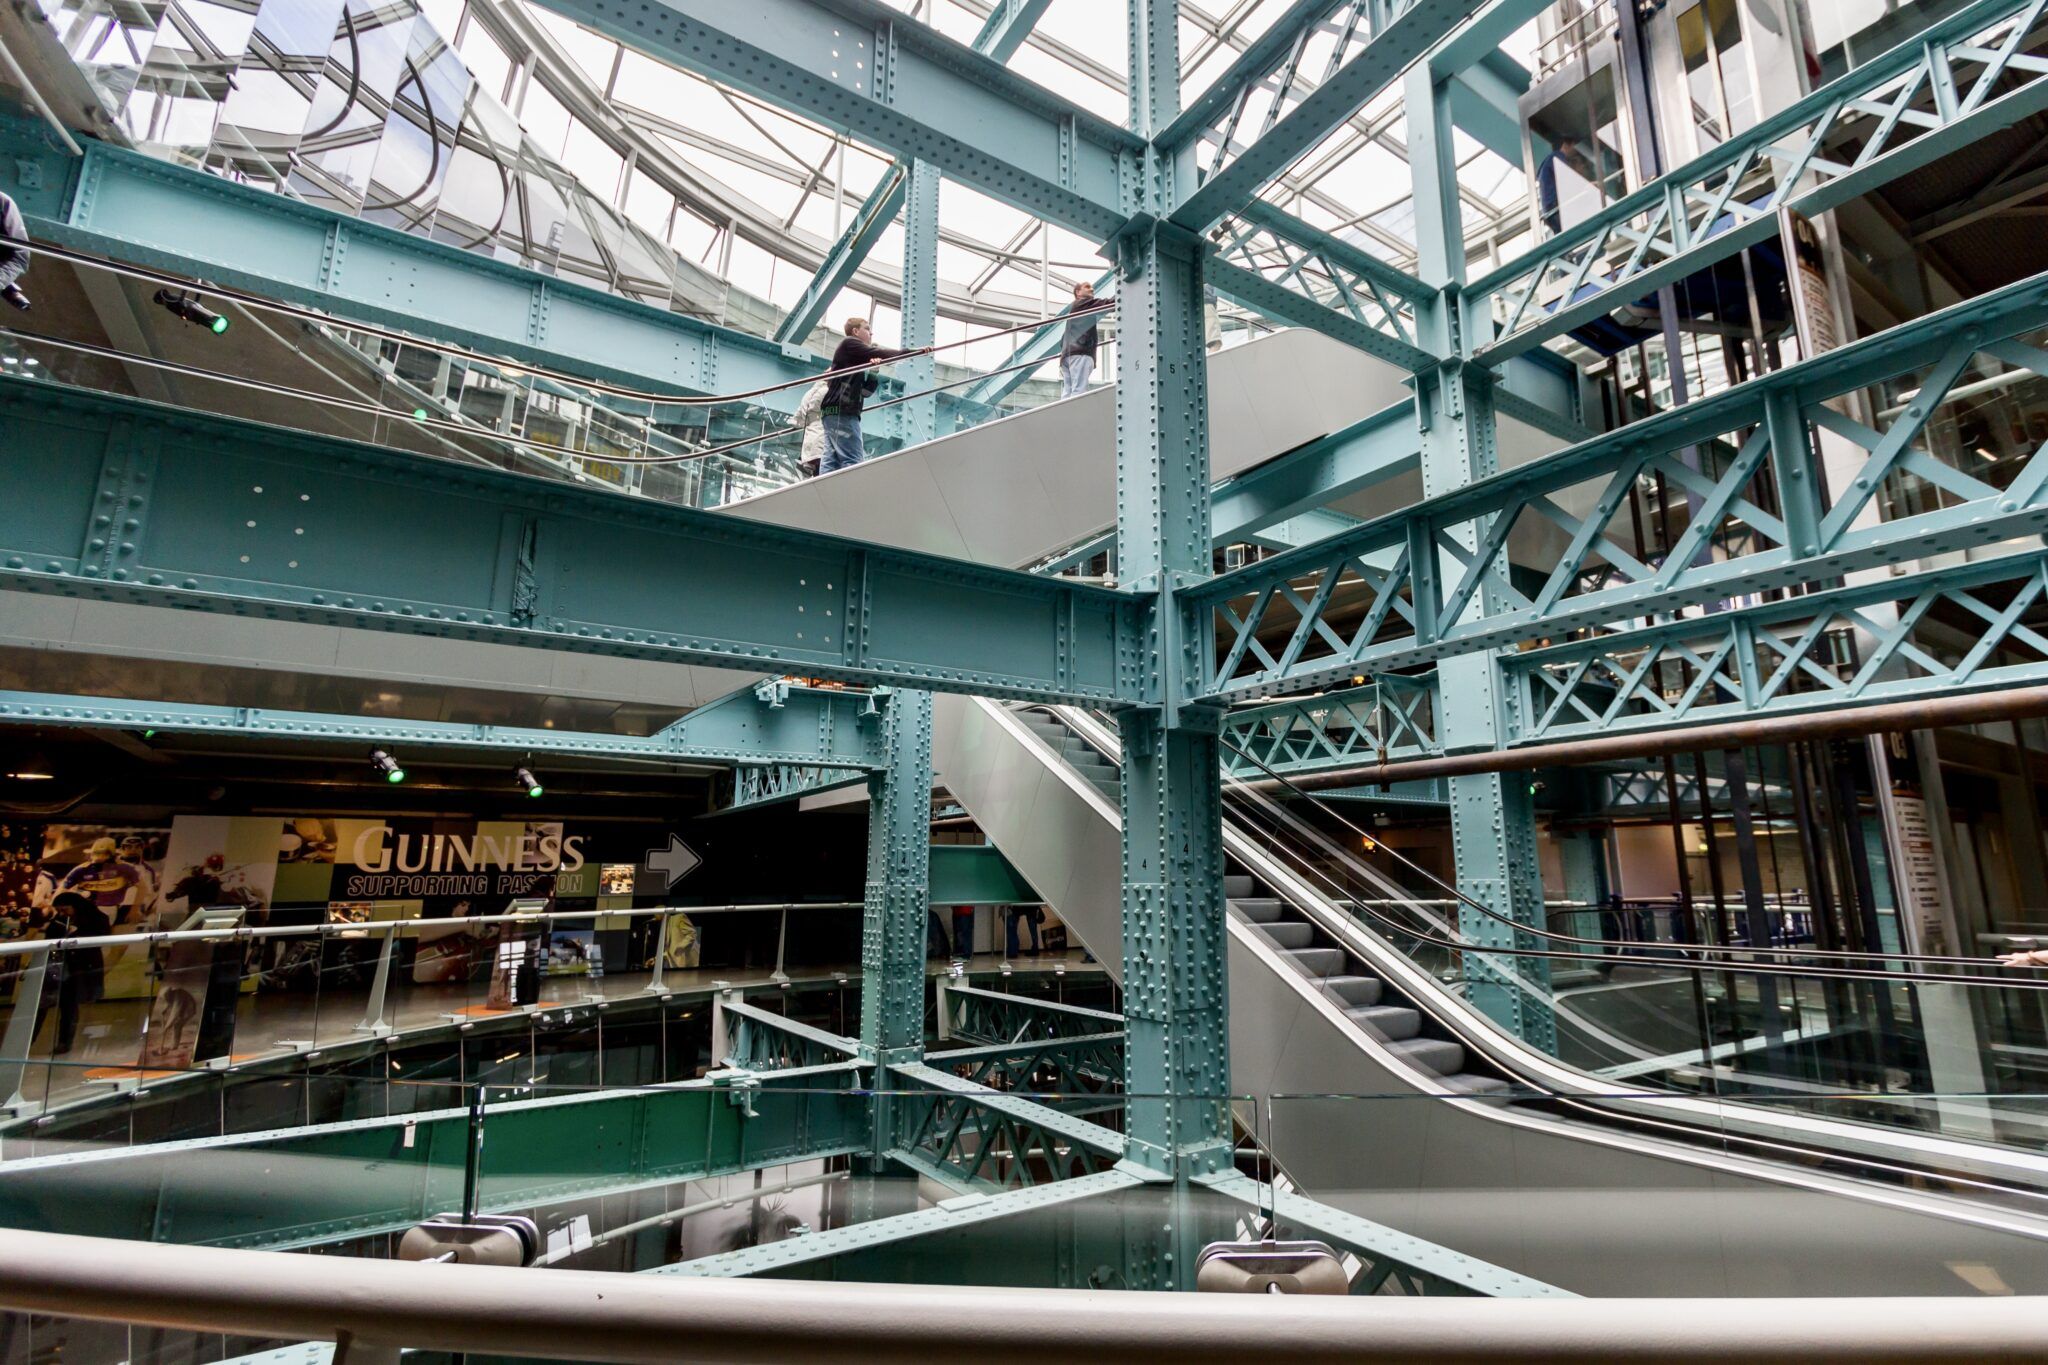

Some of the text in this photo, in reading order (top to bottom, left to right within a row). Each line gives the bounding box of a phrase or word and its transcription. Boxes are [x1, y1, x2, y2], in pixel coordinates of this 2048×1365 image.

[1169, 363, 1175, 374] 5
[353, 826, 584, 873] GUINNESS
[1183, 842, 1189, 855] 4
[1142, 858, 1147, 870] 4
[347, 874, 583, 896] SUPPORTING PASON
